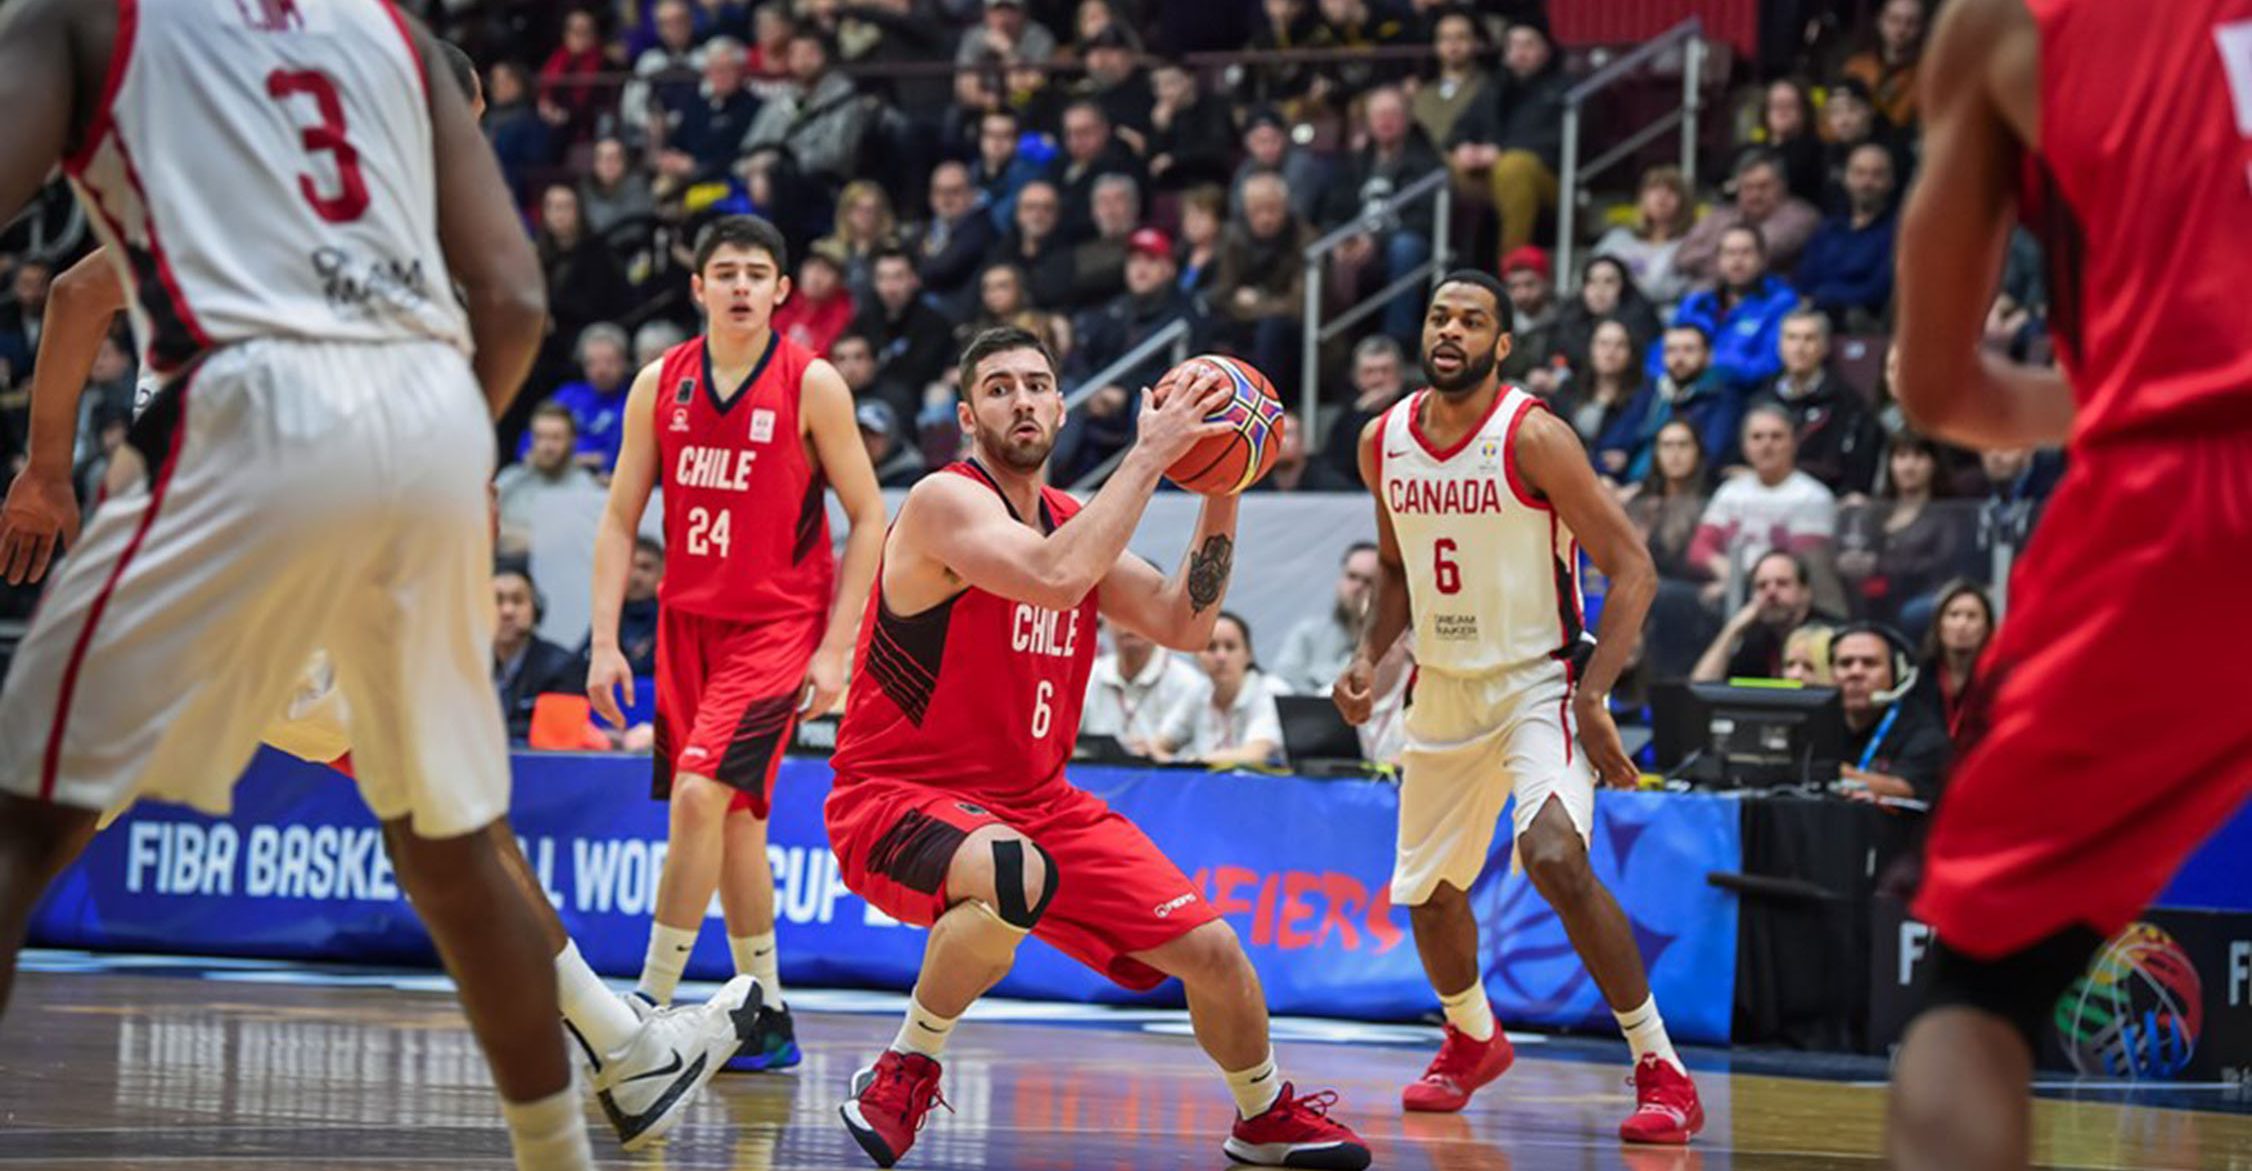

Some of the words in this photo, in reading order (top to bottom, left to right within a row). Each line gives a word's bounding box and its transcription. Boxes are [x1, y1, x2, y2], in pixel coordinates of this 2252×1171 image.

[265, 68, 370, 225] 3
[675, 446, 757, 492] CHILE
[1389, 479, 1502, 514] CANADA
[687, 506, 731, 558] 24
[1434, 537, 1462, 595] 6
[1031, 679, 1054, 739] 6
[127, 821, 239, 895] FIBA
